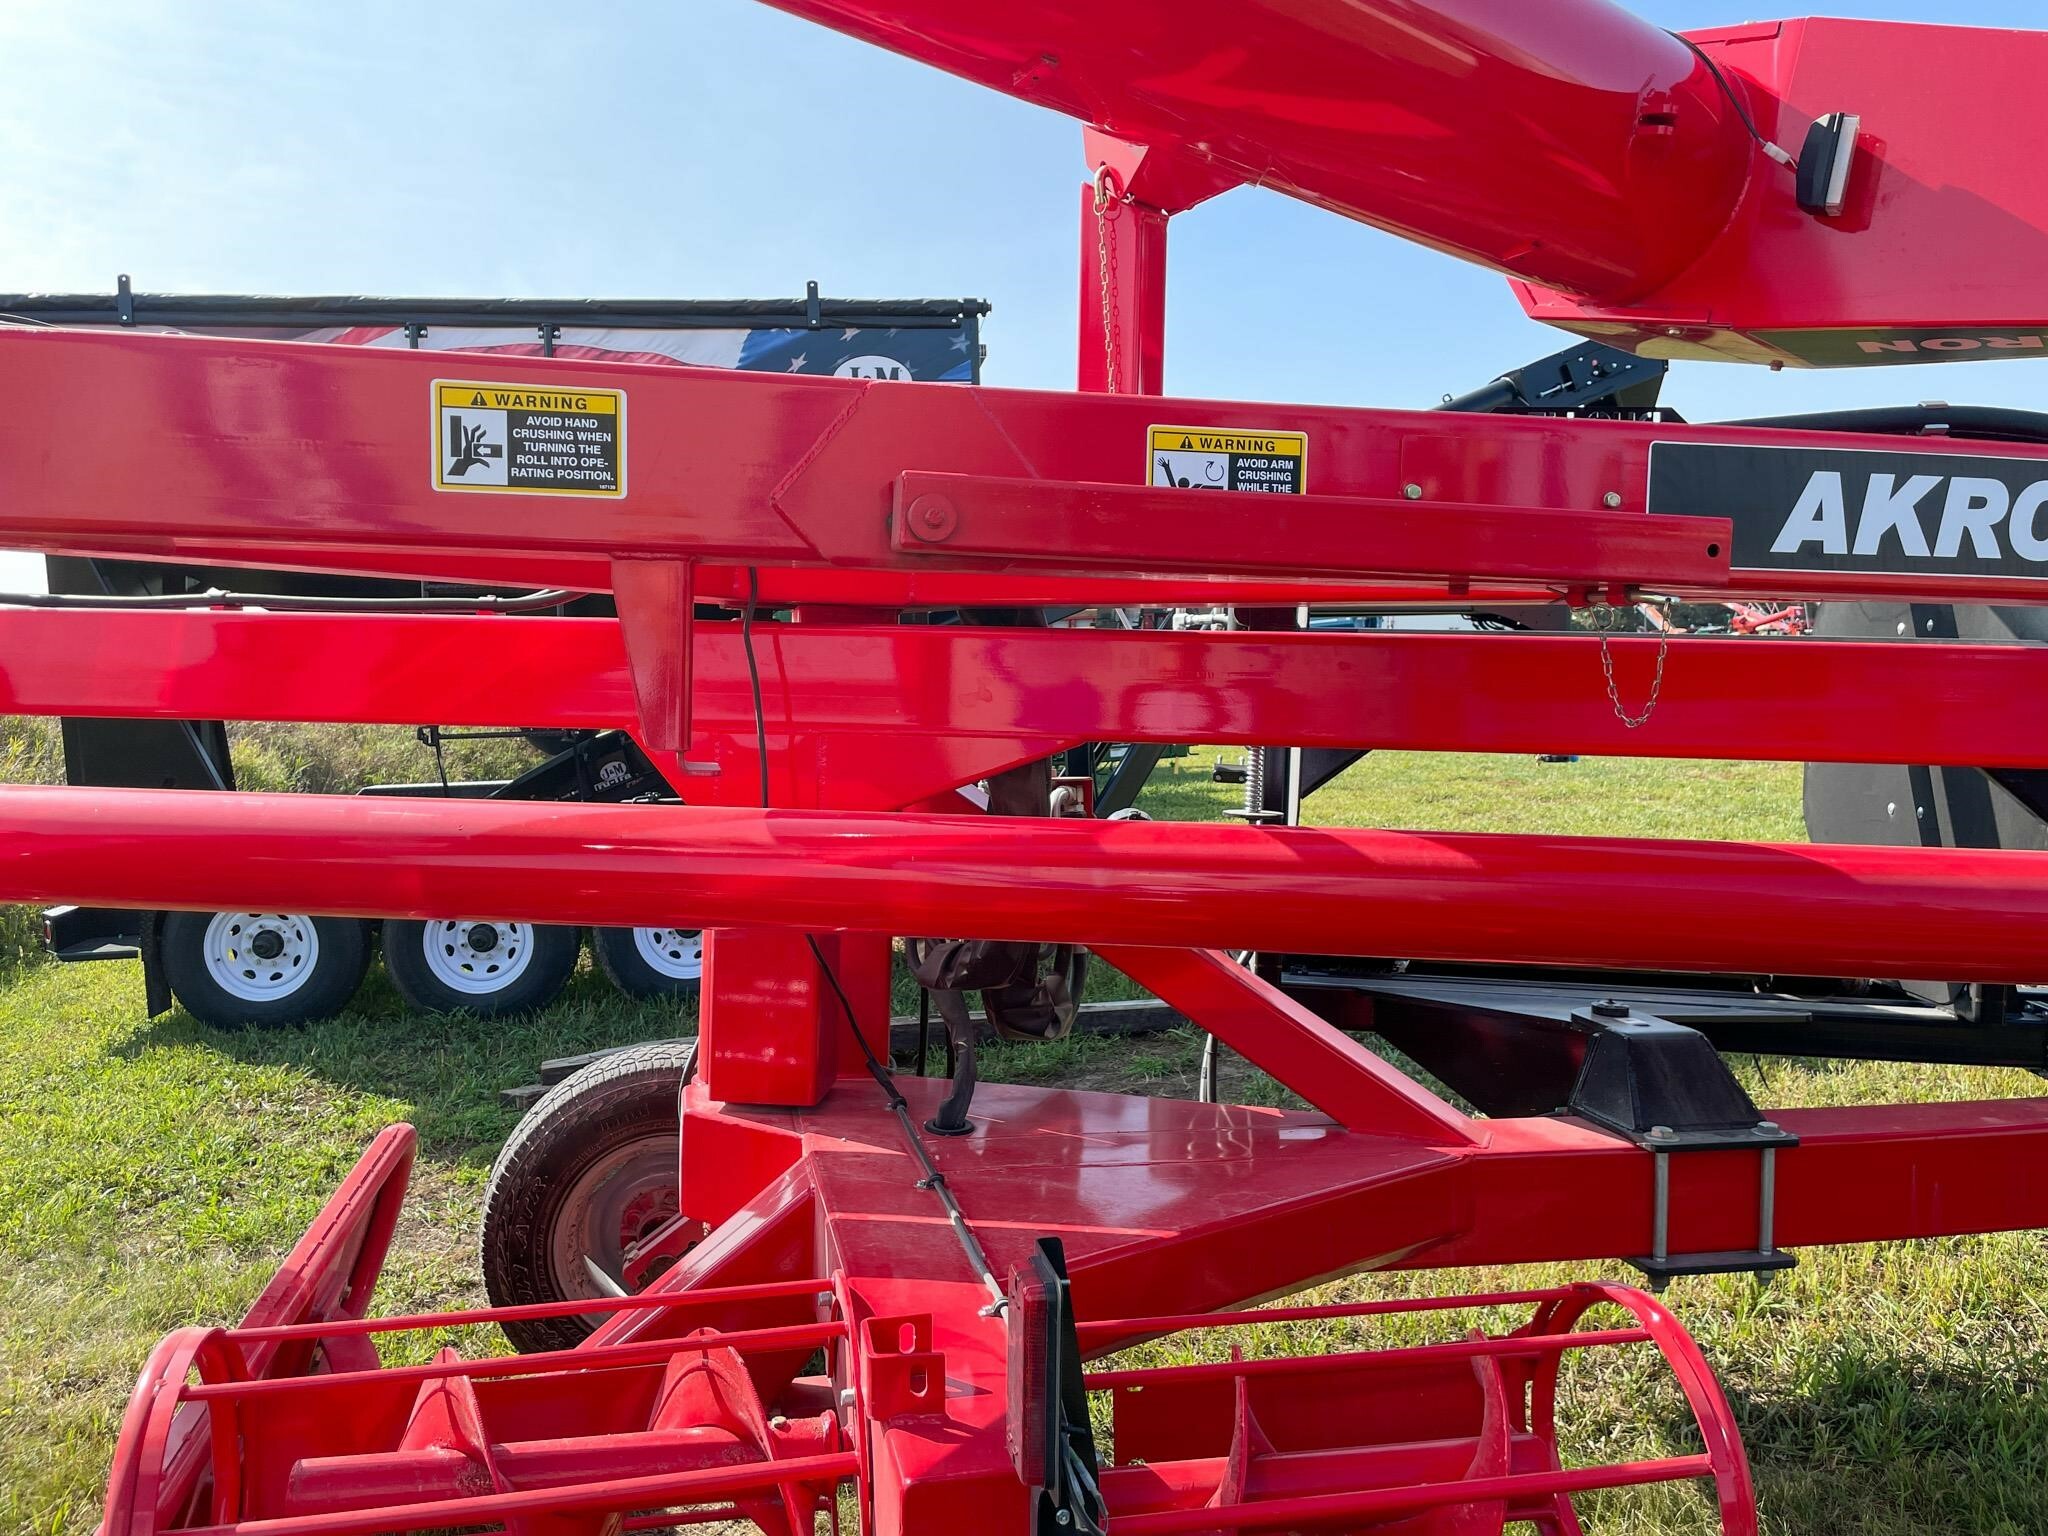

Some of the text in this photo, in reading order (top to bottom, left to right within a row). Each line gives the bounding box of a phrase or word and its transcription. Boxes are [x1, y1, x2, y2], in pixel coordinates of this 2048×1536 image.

[1857, 335, 2048, 353] RON
[495, 393, 588, 411] WARNING
[526, 416, 598, 428] AVOID HAND
[512, 428, 612, 442] CRUSHING WHEN
[523, 441, 601, 455] TURNING THE
[1200, 437, 1276, 452] WARNING
[516, 455, 608, 468] ROLL INTO OPE-
[1236, 458, 1294, 470] AVOID ARM
[511, 467, 614, 481] RATING POSITION.
[1238, 470, 1292, 481] CRUSHING
[1237, 482, 1292, 493] WHILE THE
[1769, 470, 2048, 562] AKRO
